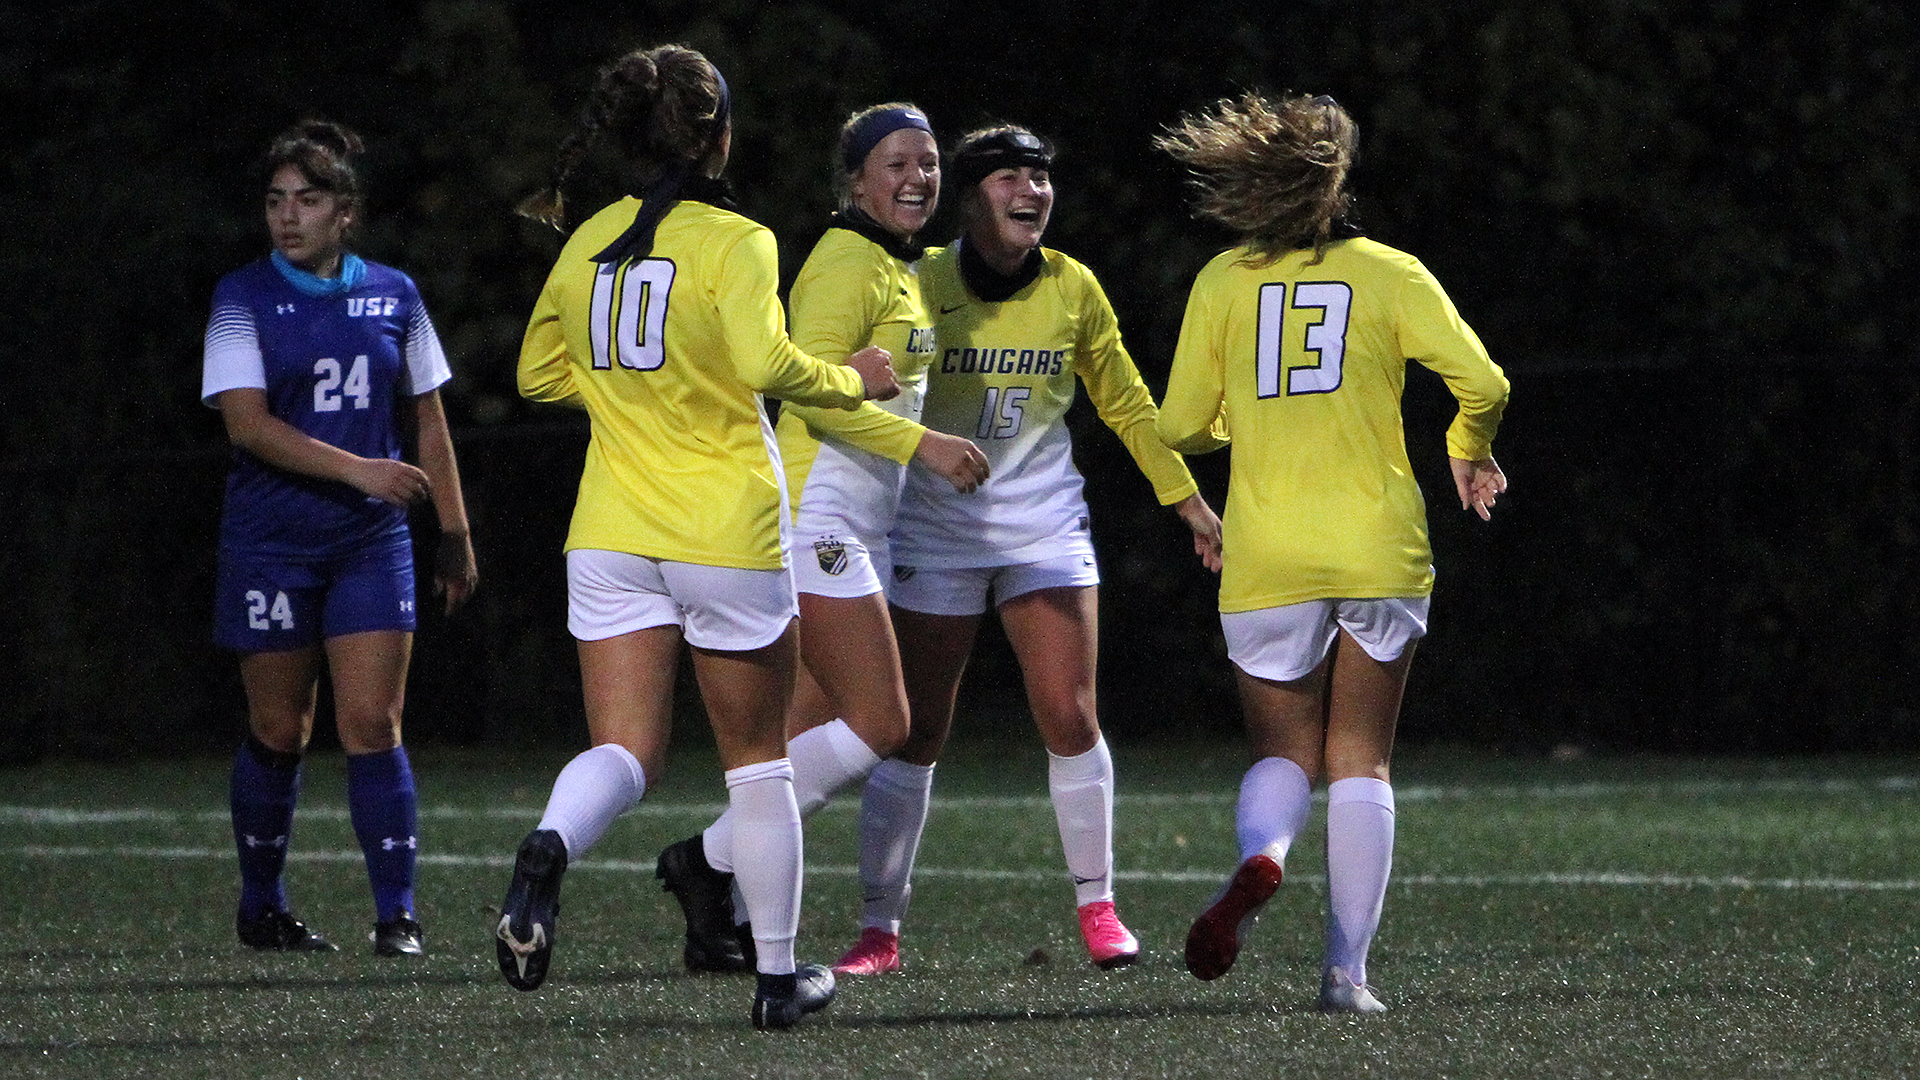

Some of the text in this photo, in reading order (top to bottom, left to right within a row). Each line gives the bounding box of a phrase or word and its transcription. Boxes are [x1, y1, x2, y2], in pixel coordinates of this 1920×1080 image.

[346, 297, 399, 317] USF
[589, 257, 676, 371] 10
[941, 348, 1065, 375] COUGARS
[1255, 281, 1353, 399] 13
[313, 355, 371, 412] 24
[975, 386, 1032, 439] 15
[245, 590, 294, 630] 24
